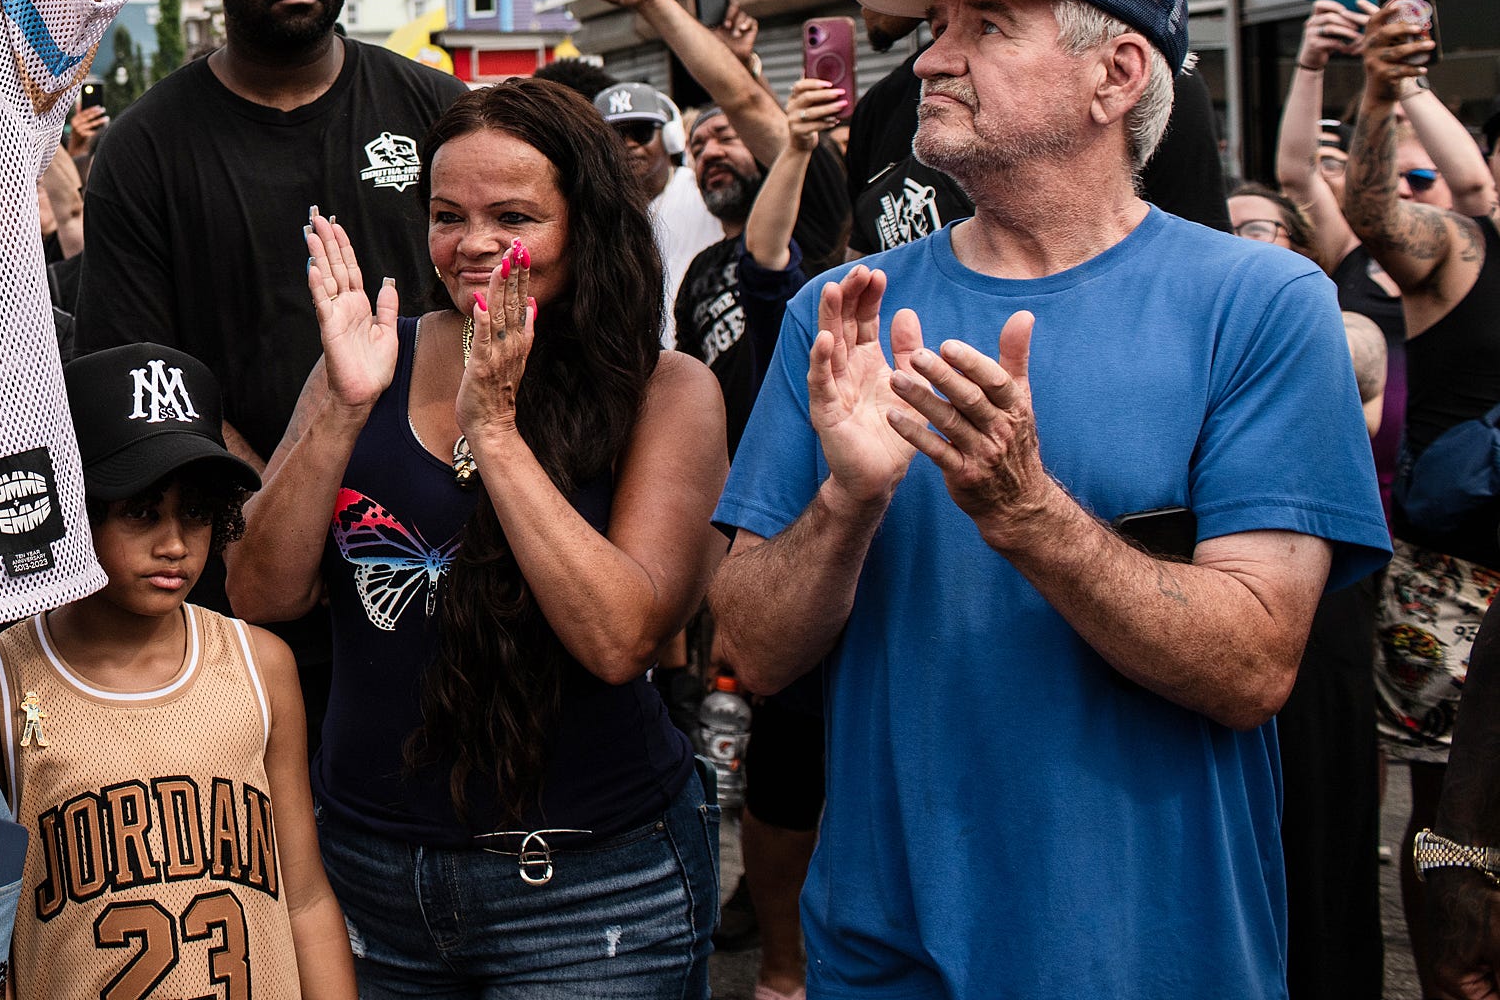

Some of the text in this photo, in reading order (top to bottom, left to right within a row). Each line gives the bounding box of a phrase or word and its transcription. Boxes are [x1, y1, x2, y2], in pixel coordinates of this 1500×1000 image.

[609, 90, 632, 113] NY
[12, 552, 46, 566] ANNIVERSARY
[26, 549, 41, 557] YEAR
[13, 558, 49, 572] 2013-2023
[34, 774, 279, 923] JORDAN
[93, 887, 252, 1000] 23
